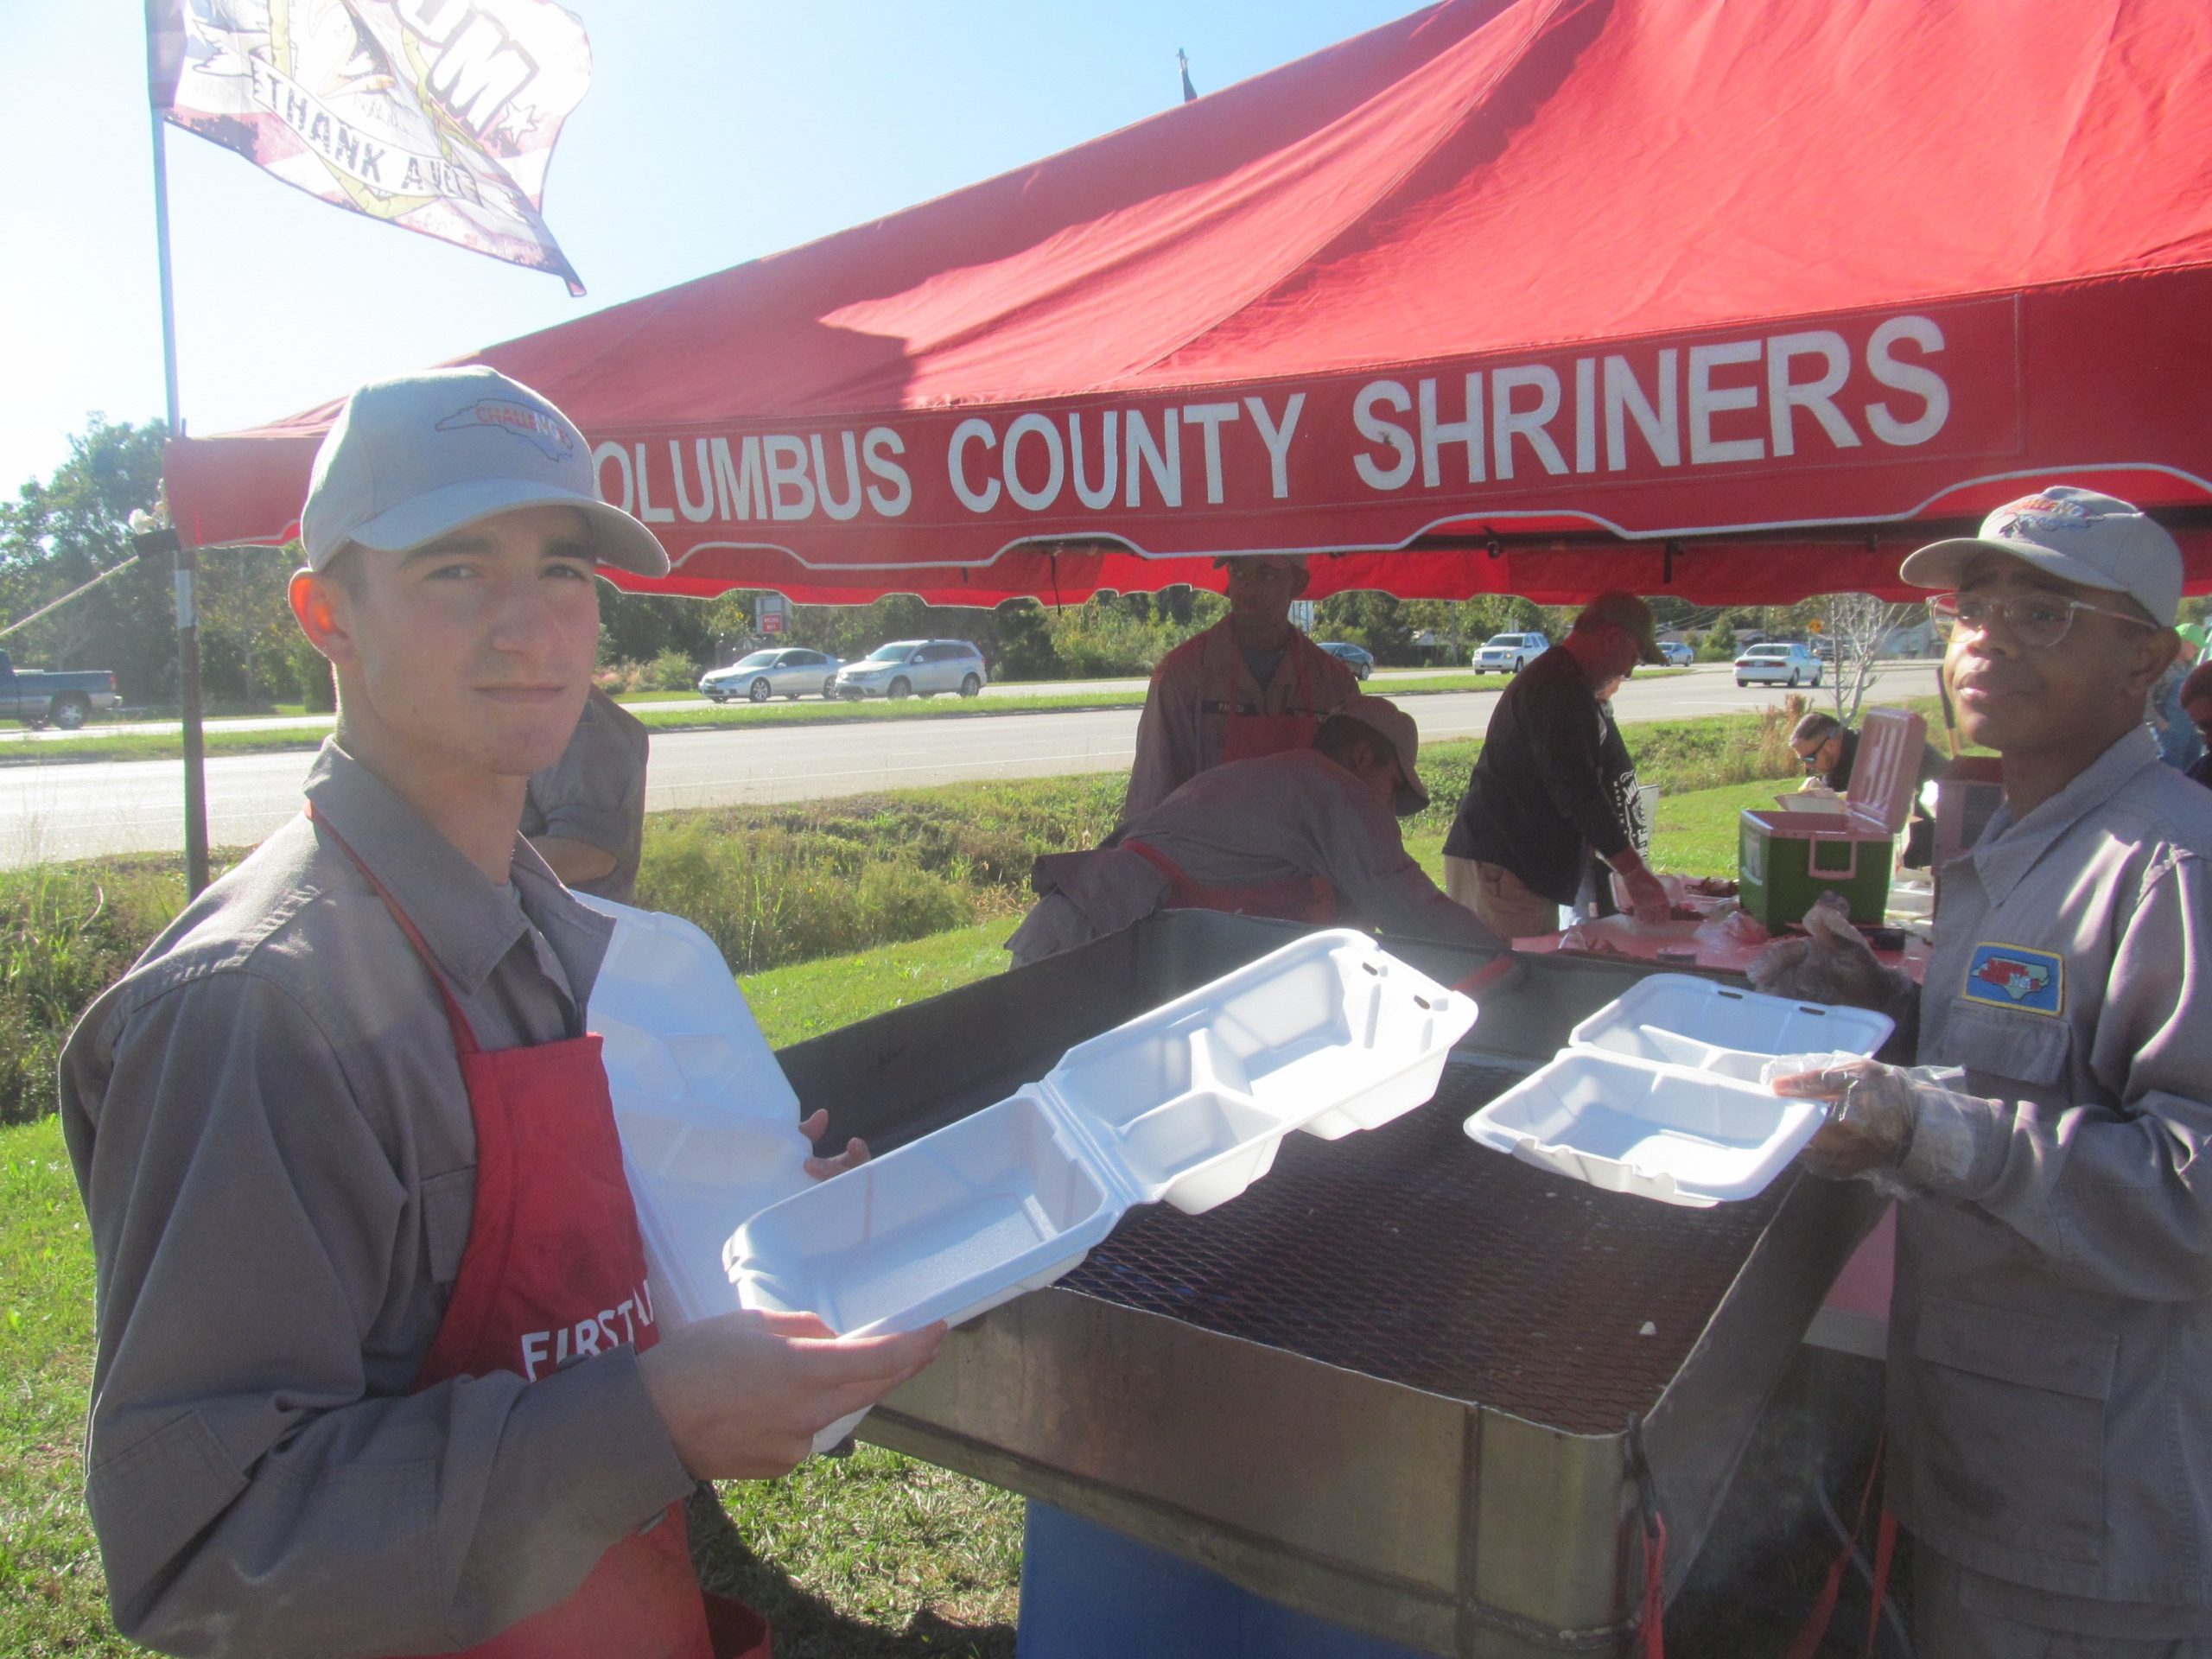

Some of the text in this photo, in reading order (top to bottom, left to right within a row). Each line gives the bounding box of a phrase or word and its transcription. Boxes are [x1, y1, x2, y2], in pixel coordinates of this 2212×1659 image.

[264, 72, 385, 184] THANK
[402, 157, 424, 190] A
[593, 315, 1950, 523] OLUMBUS COUNTY SHRINERS
